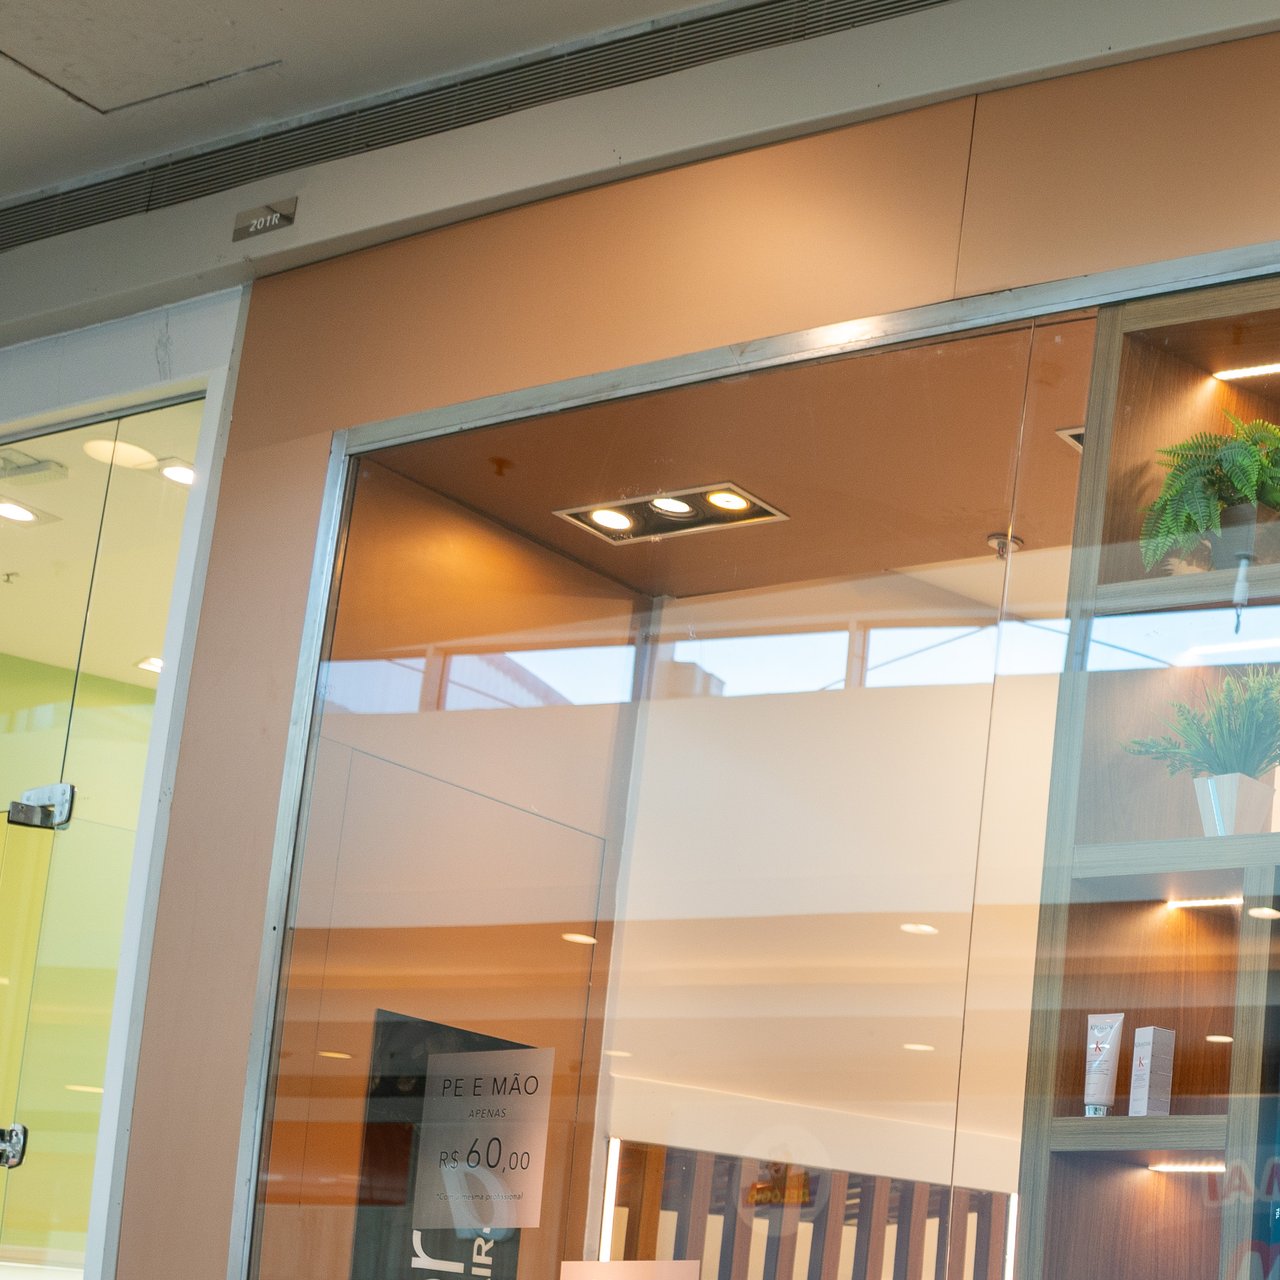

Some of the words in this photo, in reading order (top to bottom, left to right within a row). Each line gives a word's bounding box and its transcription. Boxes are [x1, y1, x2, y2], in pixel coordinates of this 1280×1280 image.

[249, 213, 280, 232] 201R
[442, 1078, 464, 1097] PE
[473, 1077, 483, 1097] E
[492, 1072, 539, 1096] MÃO
[468, 1108, 507, 1119] APENAS
